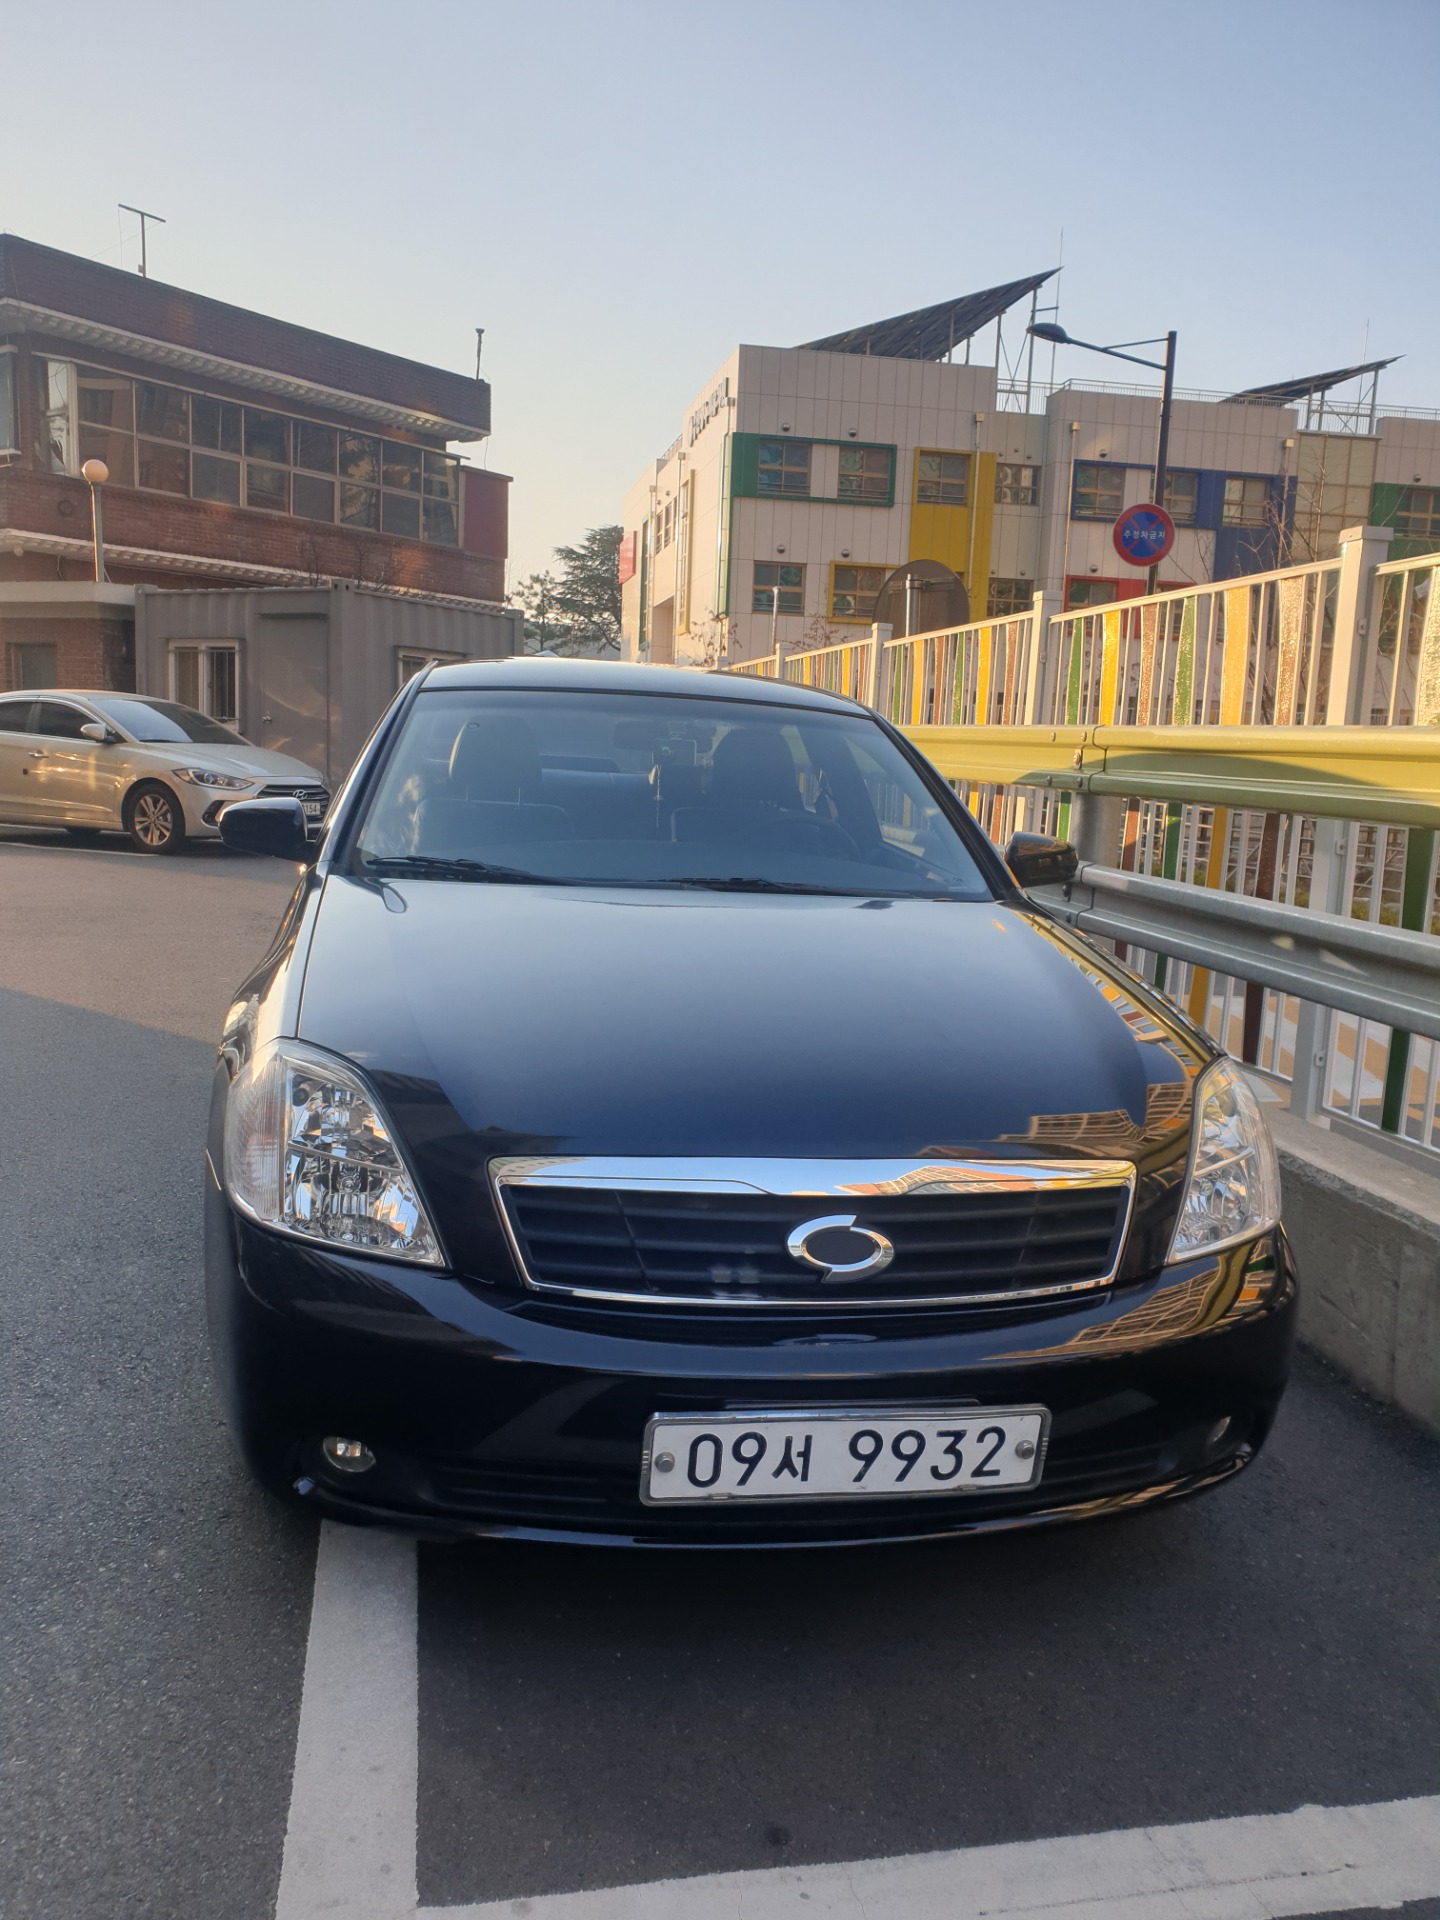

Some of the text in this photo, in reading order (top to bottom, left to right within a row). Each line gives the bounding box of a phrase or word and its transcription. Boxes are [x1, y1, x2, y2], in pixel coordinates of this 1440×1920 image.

[1123, 530, 1165, 540] 주정차금지
[687, 1426, 1007, 1488] 09서 9932
